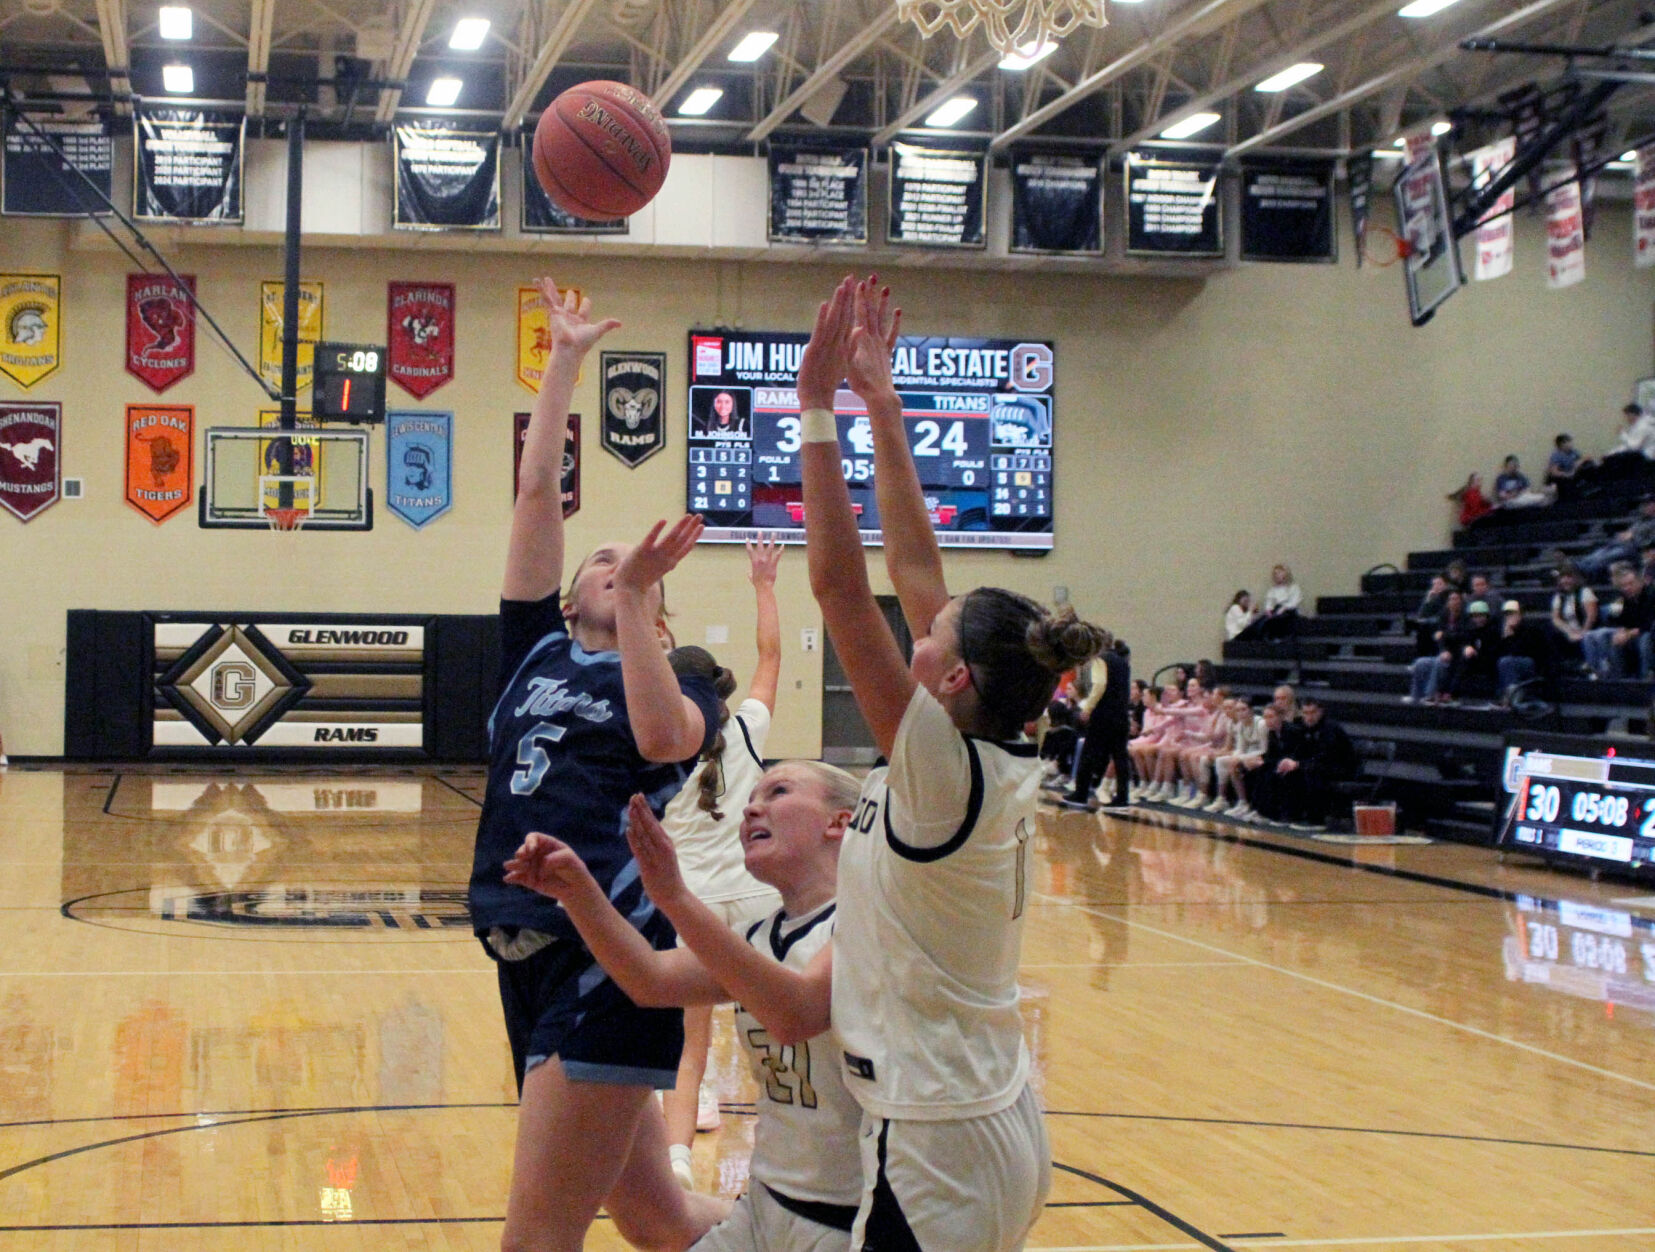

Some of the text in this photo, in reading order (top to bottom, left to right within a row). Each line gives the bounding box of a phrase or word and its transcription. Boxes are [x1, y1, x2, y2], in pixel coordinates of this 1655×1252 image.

[134, 284, 187, 302] HARLAN
[393, 290, 449, 308] CLARINDA
[132, 356, 187, 369] CYCLONES
[337, 351, 379, 373] 5:08
[725, 342, 1009, 378] JIM HU AL ESTATE
[392, 364, 448, 377] CARDINALS
[736, 371, 763, 381] YOUR
[764, 372, 794, 382] LOCAL
[893, 377, 939, 387] SIDENTIAL
[342, 379, 351, 411] 1
[933, 395, 988, 410] TITANS
[133, 415, 187, 433] RED OAK
[610, 431, 656, 445] RAMS
[913, 420, 968, 457] 24
[698, 451, 746, 463] 1 5 2
[758, 455, 791, 464] FOULS
[1037, 459, 1045, 469] 1
[696, 465, 746, 478] 3 5 2
[768, 466, 781, 482] 1
[962, 469, 976, 486] 0
[1037, 474, 1045, 484] 1
[0, 482, 54, 494] MUSTANGS
[136, 488, 183, 500] TIGERS
[738, 483, 746, 493] 0
[1037, 489, 1045, 499] 1
[394, 495, 442, 507] TITANS
[694, 497, 746, 509] 21 4 0
[1037, 504, 1045, 515] 1
[288, 629, 408, 646] GLENWOOD
[210, 661, 256, 710] G
[514, 676, 614, 723] Titans
[313, 727, 379, 742] RAMS
[510, 721, 568, 796] 5
[1526, 784, 1561, 823] 30
[1572, 791, 1629, 827] 05:08
[747, 1028, 818, 1110] 21
